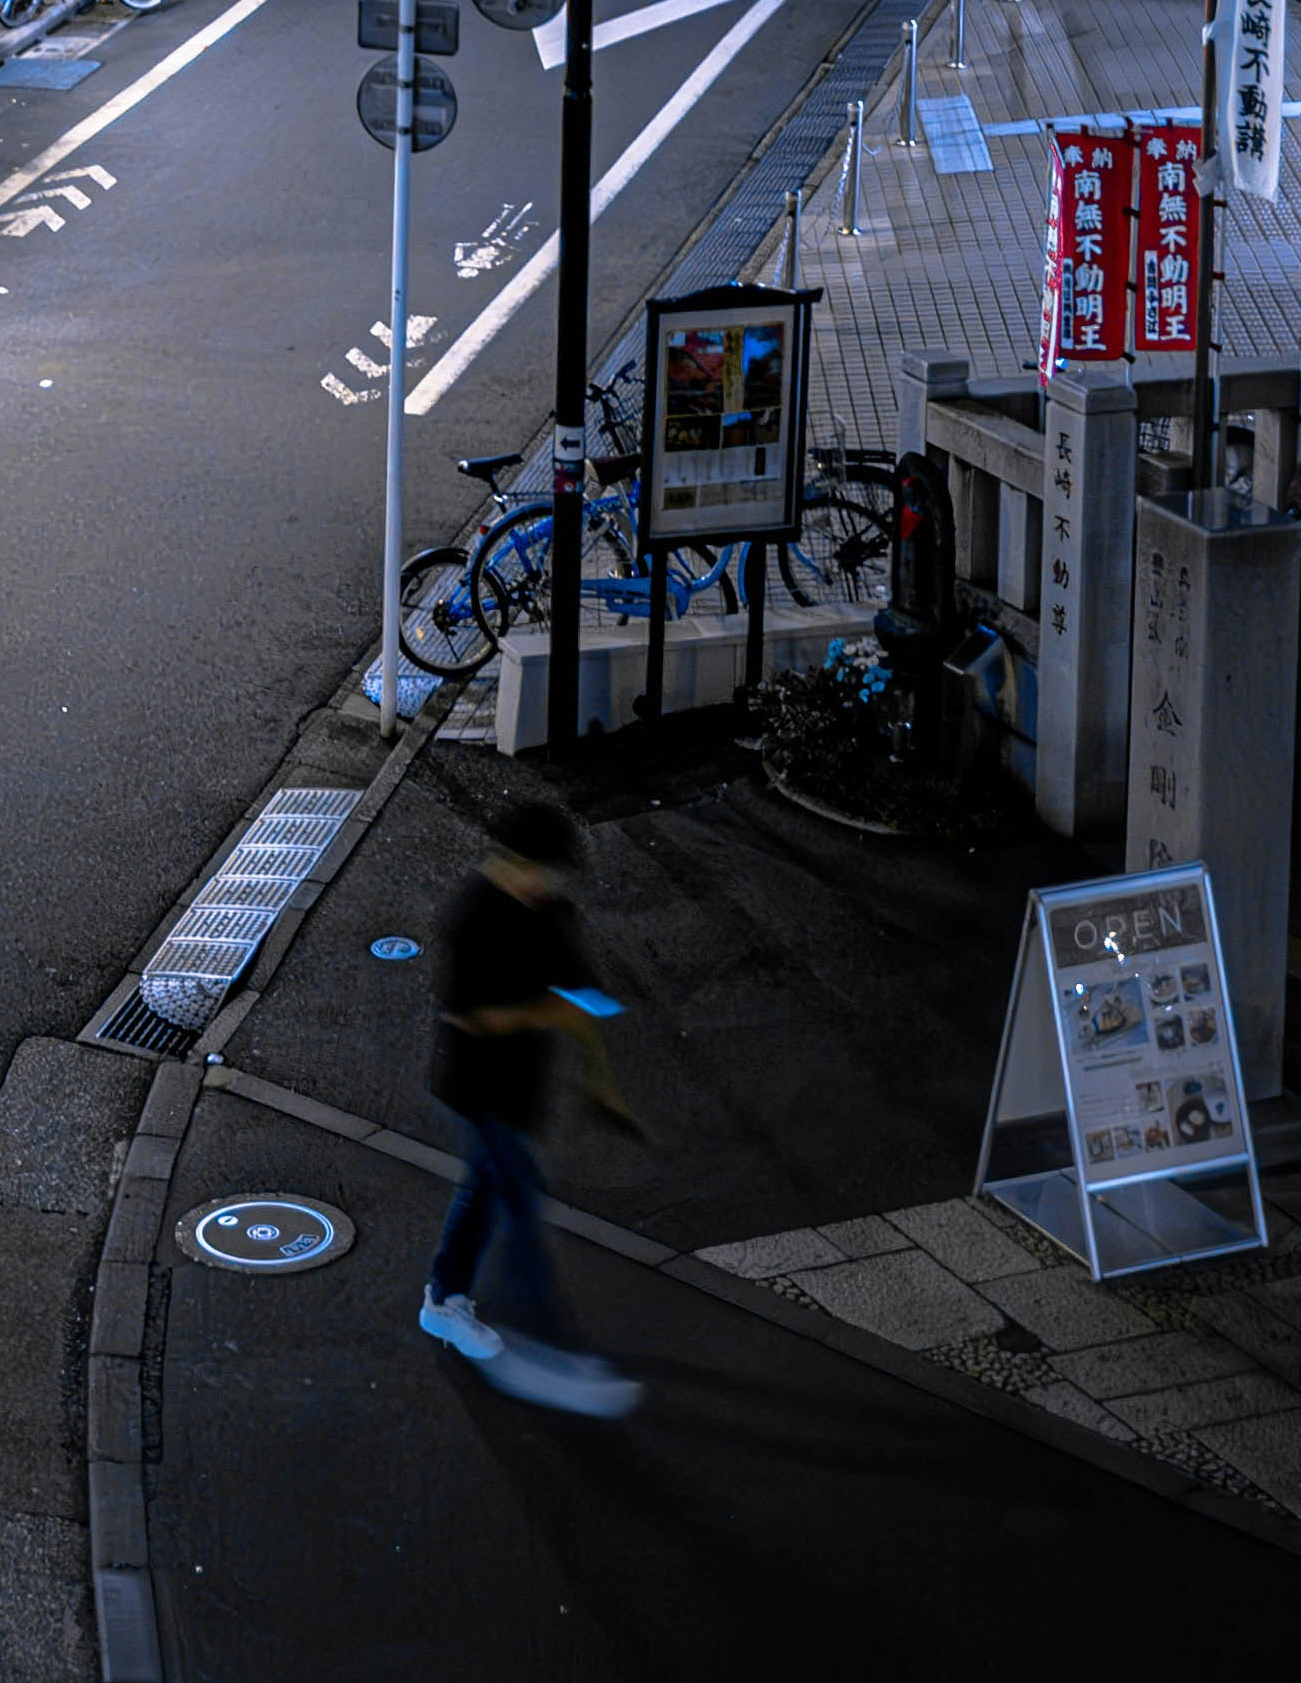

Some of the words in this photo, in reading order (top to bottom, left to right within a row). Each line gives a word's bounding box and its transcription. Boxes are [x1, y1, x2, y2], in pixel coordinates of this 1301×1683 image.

[1064, 144, 1115, 170] 奉納
[1145, 136, 1198, 161] 奉納
[1073, 169, 1107, 352] 南無不動明王
[1156, 162, 1192, 341] 南無不動明王
[1073, 905, 1184, 951] OPEN
